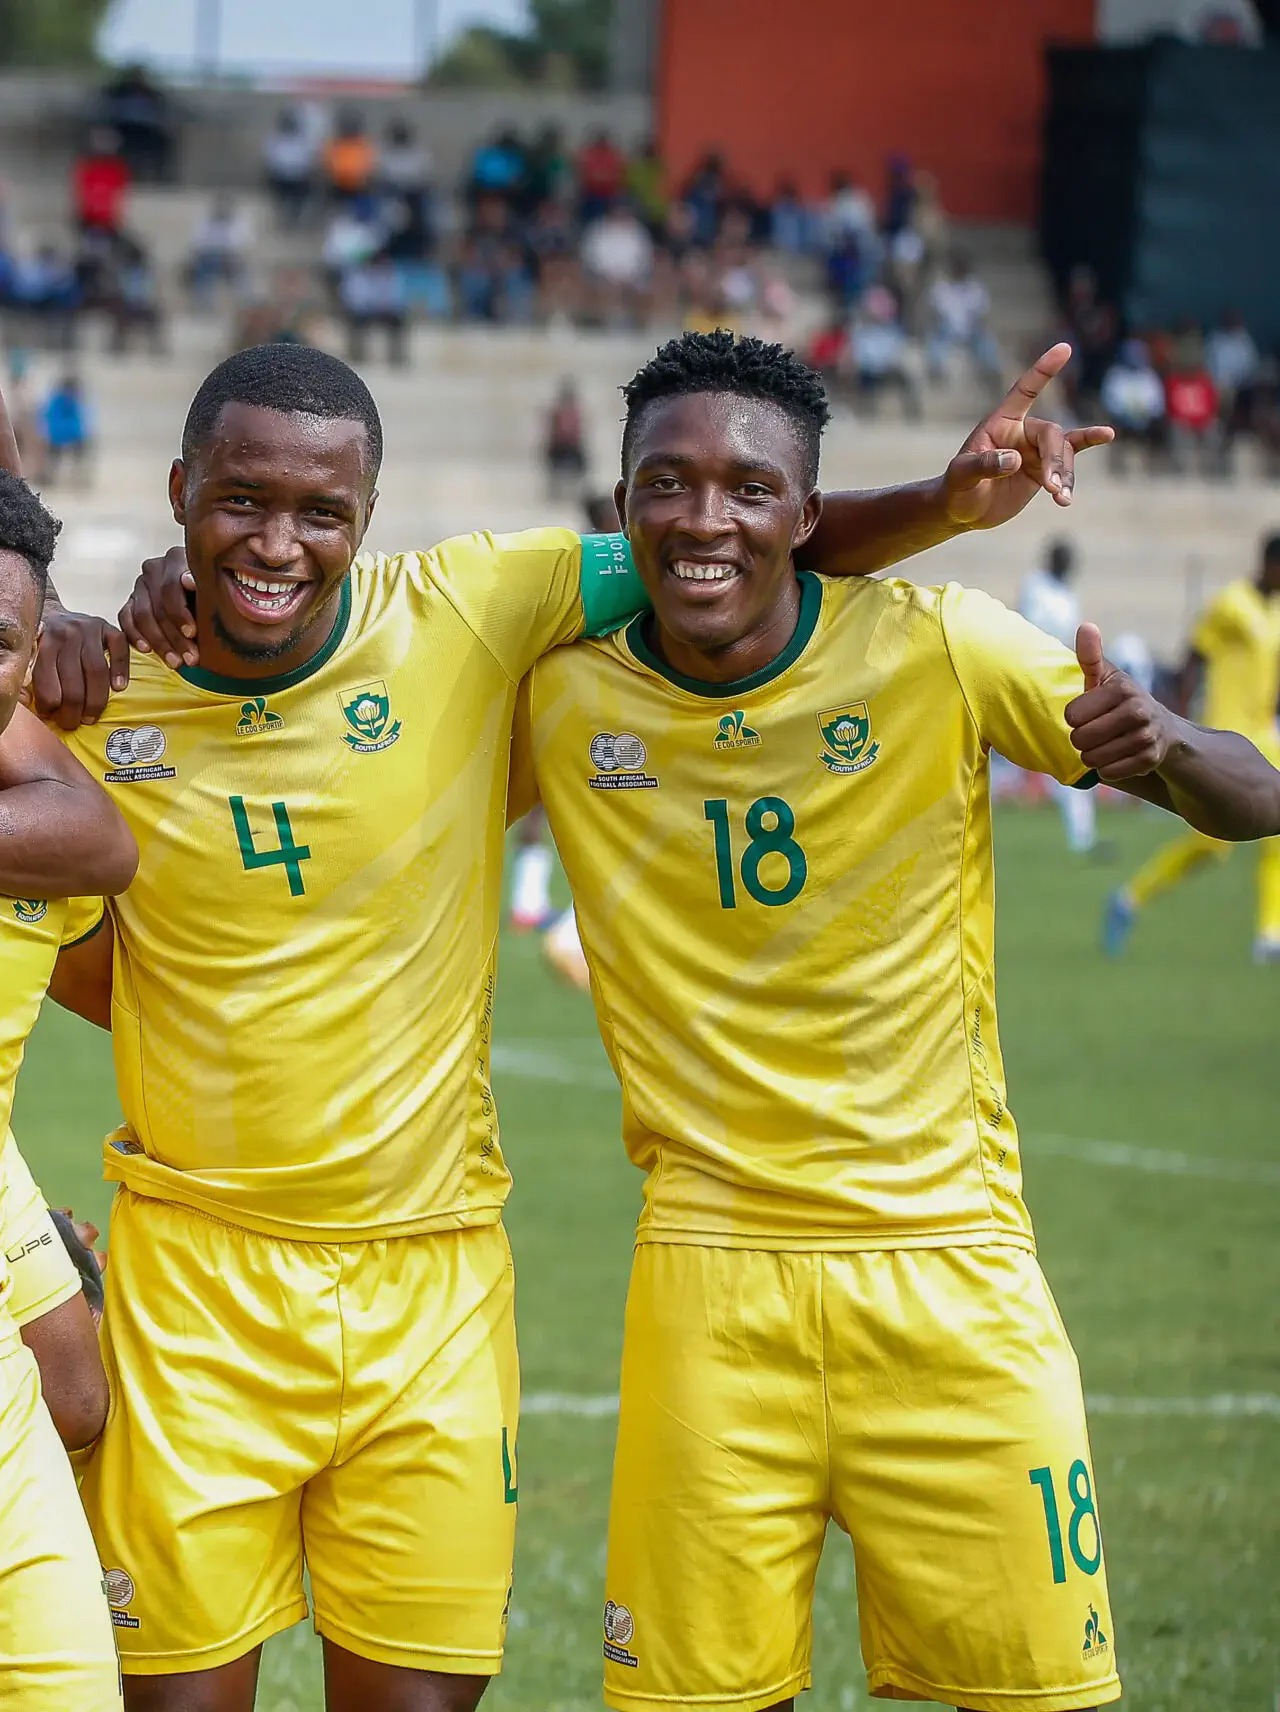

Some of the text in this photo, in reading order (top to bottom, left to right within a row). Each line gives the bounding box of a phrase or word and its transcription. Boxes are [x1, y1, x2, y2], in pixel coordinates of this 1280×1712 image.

[237, 720, 283, 735] LE COQ SPORTIF
[353, 734, 398, 752] SOUTH AFRICA
[714, 736, 760, 750] LE COQ SPORTIF
[135, 766, 163, 774] AFRICAN
[830, 756, 875, 772] SOUTH AFRICA
[134, 770, 174, 780] ASSOCIATION
[617, 780, 656, 788] ASSOCIATION
[229, 796, 311, 897] 4
[704, 796, 807, 909] 18
[1029, 1458, 1101, 1585] 18
